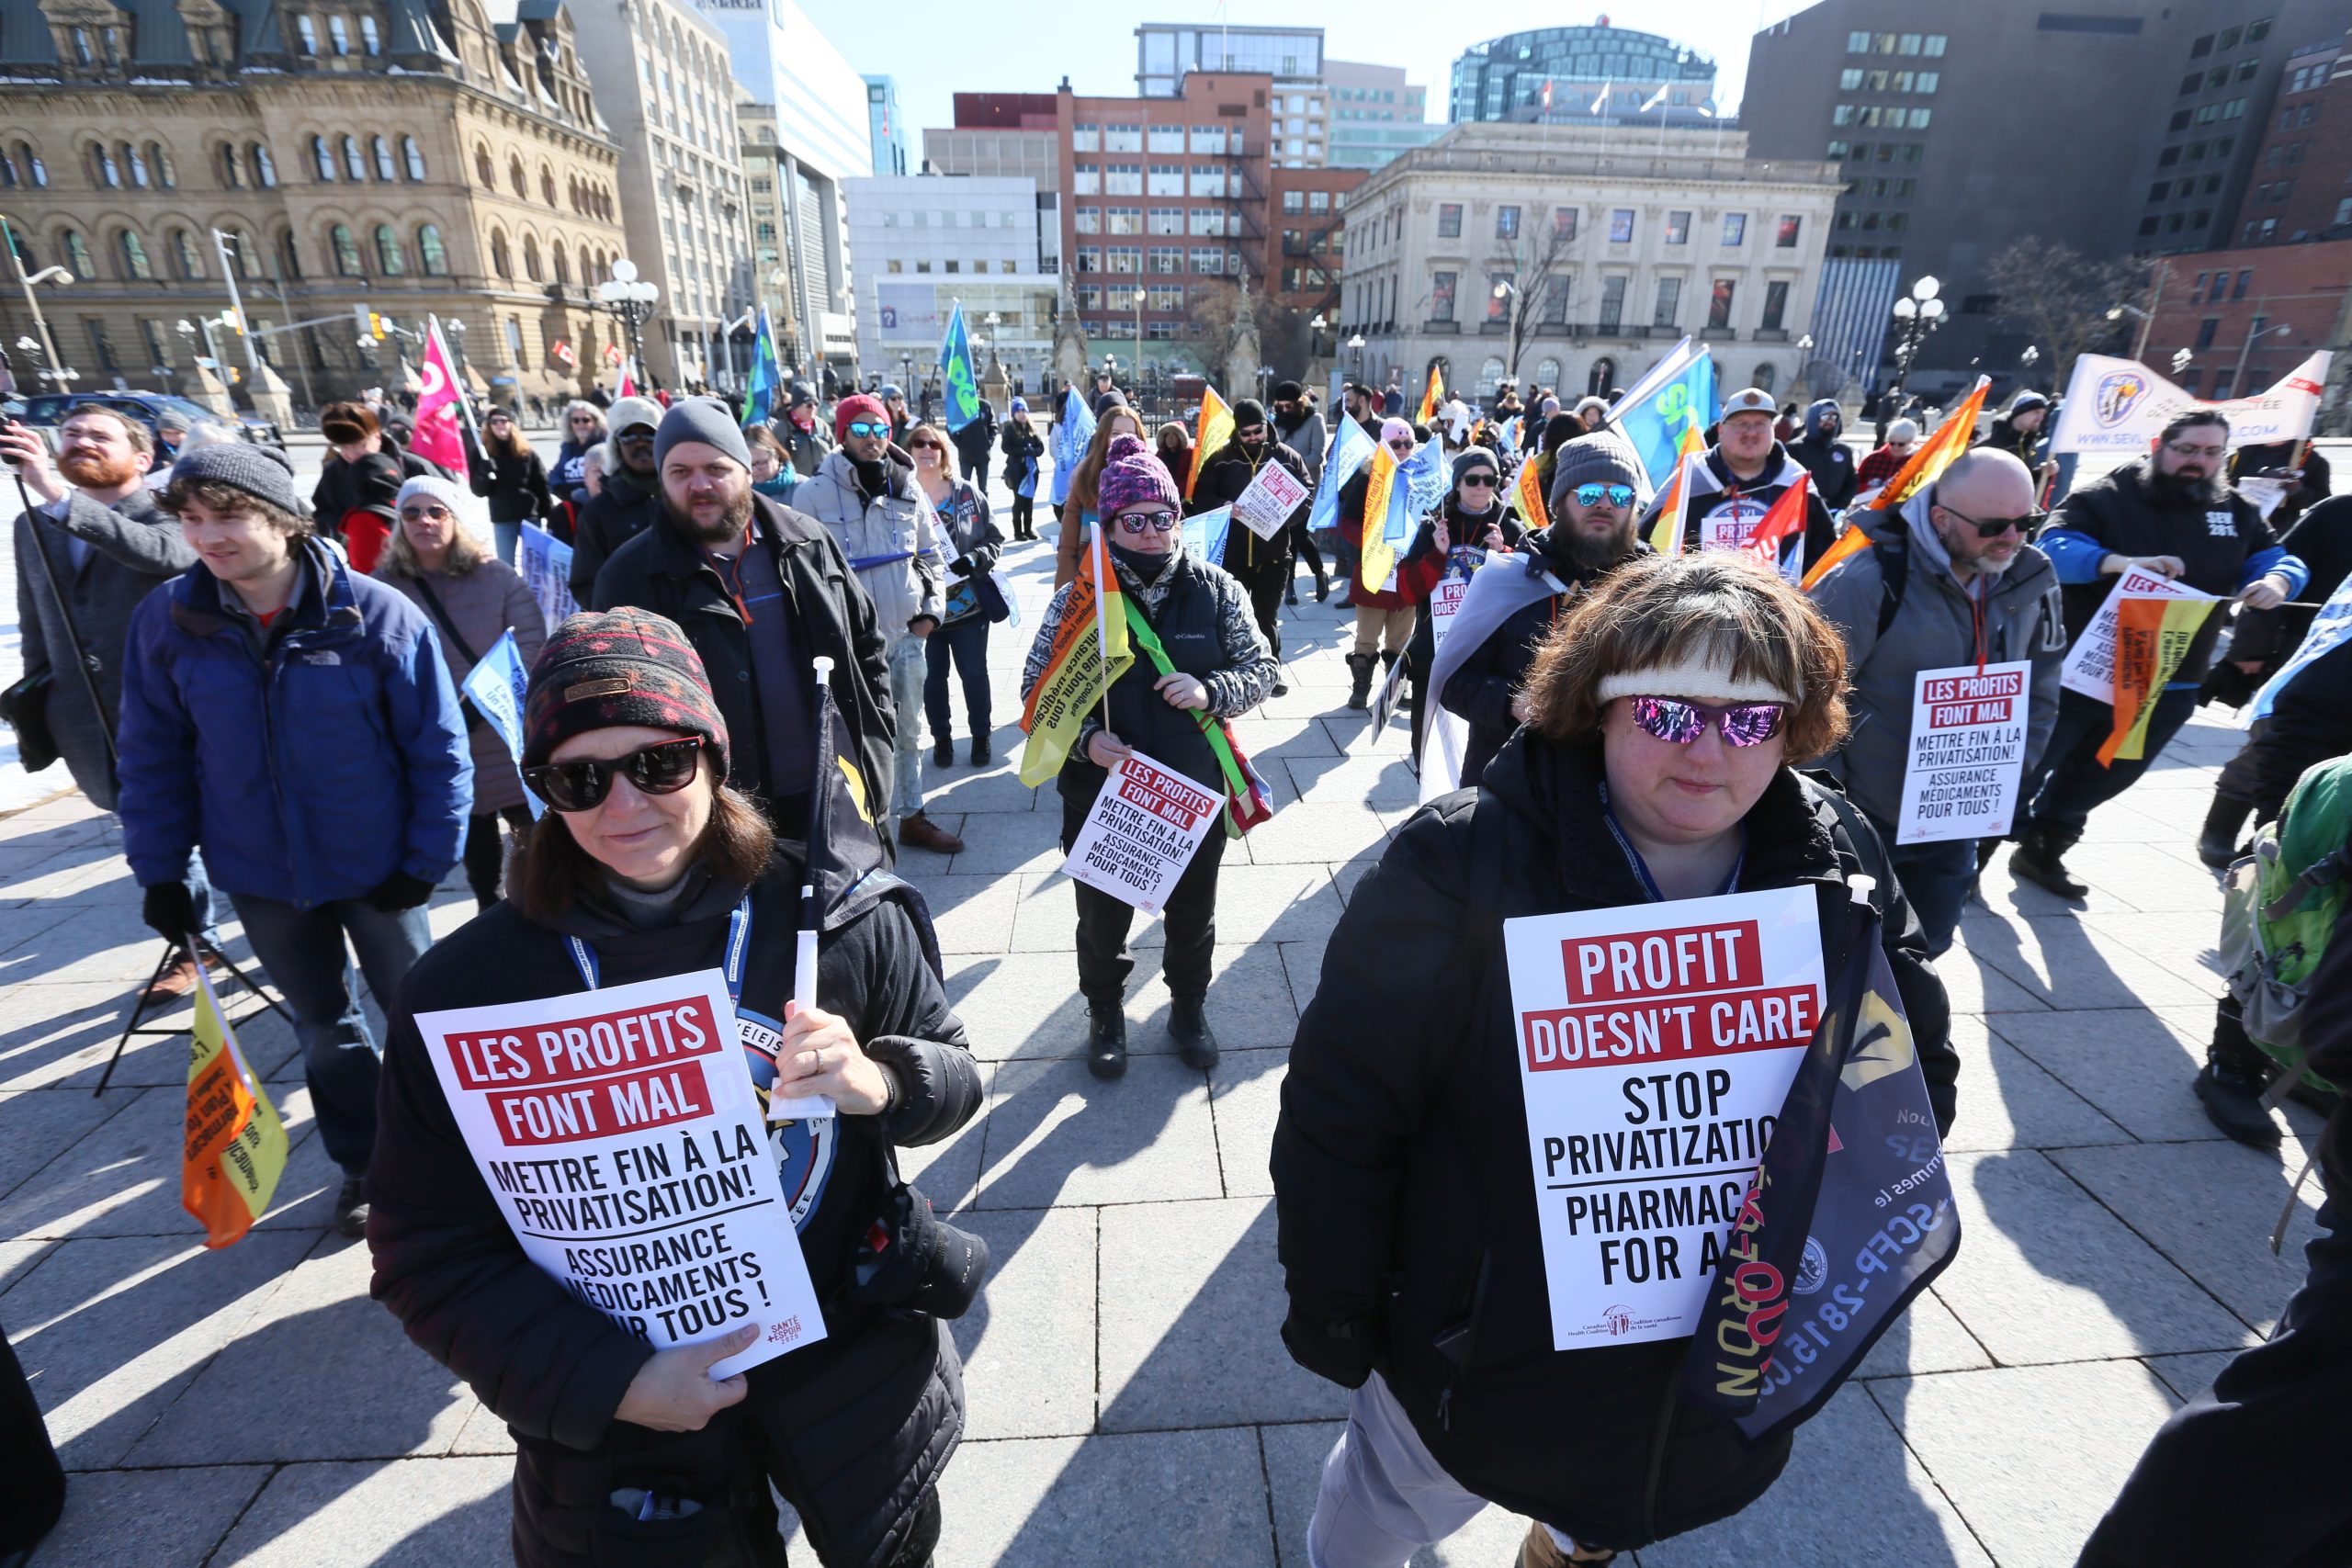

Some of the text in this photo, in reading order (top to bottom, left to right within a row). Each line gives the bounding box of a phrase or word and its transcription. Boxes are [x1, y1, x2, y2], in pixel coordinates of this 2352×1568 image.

[1263, 477, 1280, 494] FONT
[1277, 475, 1302, 502] PROFITS
[1435, 601, 1462, 615] DOES
[1446, 584, 1467, 599] PRO
[1928, 674, 2019, 701] LES PROFITS
[2074, 660, 2105, 681] POUR
[1935, 702, 2007, 726] FONT MAL
[1916, 726, 2021, 751] METTRE FIN À LA
[1917, 744, 2017, 768] PRIVATISATION!
[1125, 760, 1210, 815] LES PROFITS
[1919, 784, 2003, 804] MÉDICAMENTS
[1929, 768, 1997, 786] ASSURANCE
[1101, 795, 1194, 852] METTRE FIN À LA
[1124, 781, 1190, 829] FONT MAL
[1917, 802, 1952, 819] POUR
[1957, 799, 1990, 816] TOUS
[1098, 811, 1184, 862] PRIVATISATION!
[1102, 833, 1163, 870] ASSURANCE
[1085, 852, 1118, 875] POUR
[1118, 867, 1150, 892] TOUS
[1091, 840, 1163, 885] MÉDICAMENTS
[1577, 928, 1744, 996] PROFIT
[1710, 992, 1813, 1048] CARE
[458, 1004, 707, 1083] LES PROFITS
[502, 1071, 700, 1140] FONT MAL
[1622, 1067, 1731, 1125] STOP
[488, 1122, 759, 1194] METTRE FIN À LA
[1544, 1113, 1778, 1178] PRIVATIZATIO
[513, 1164, 756, 1232] PRIVATISATION!
[1566, 1179, 1746, 1236] PHARMAC
[564, 1224, 732, 1278] ASSURANCE
[1600, 1234, 1731, 1286] FOR A
[566, 1251, 762, 1313] MÉDICAMENTS
[655, 1288, 750, 1343] TOUS
[771, 1314, 799, 1334] SANTÉ
[1653, 1314, 1683, 1323] canadienne
[781, 1334, 799, 1345] 2025
